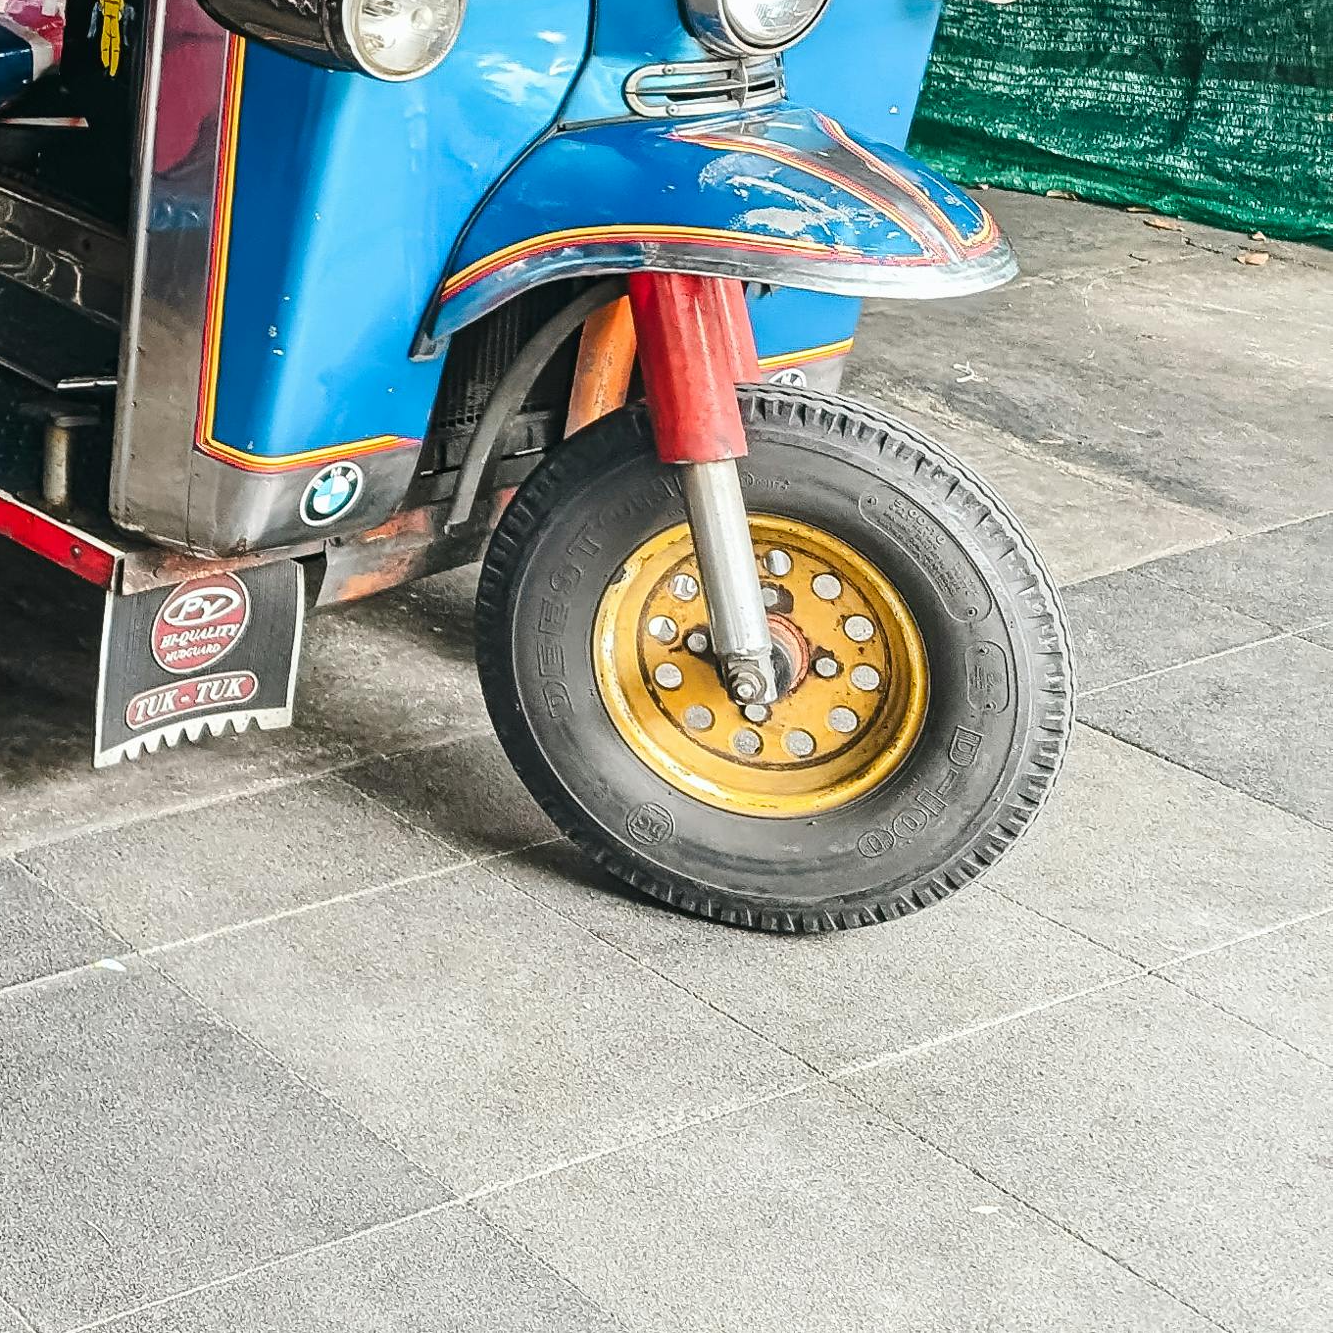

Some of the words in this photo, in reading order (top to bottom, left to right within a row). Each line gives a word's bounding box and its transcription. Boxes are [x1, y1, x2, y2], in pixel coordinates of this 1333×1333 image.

[160, 624, 240, 650] HI-QUALITY
[164, 642, 222, 664] MUDGUARD
[134, 688, 179, 723] TUK
[194, 676, 248, 704] TUK
